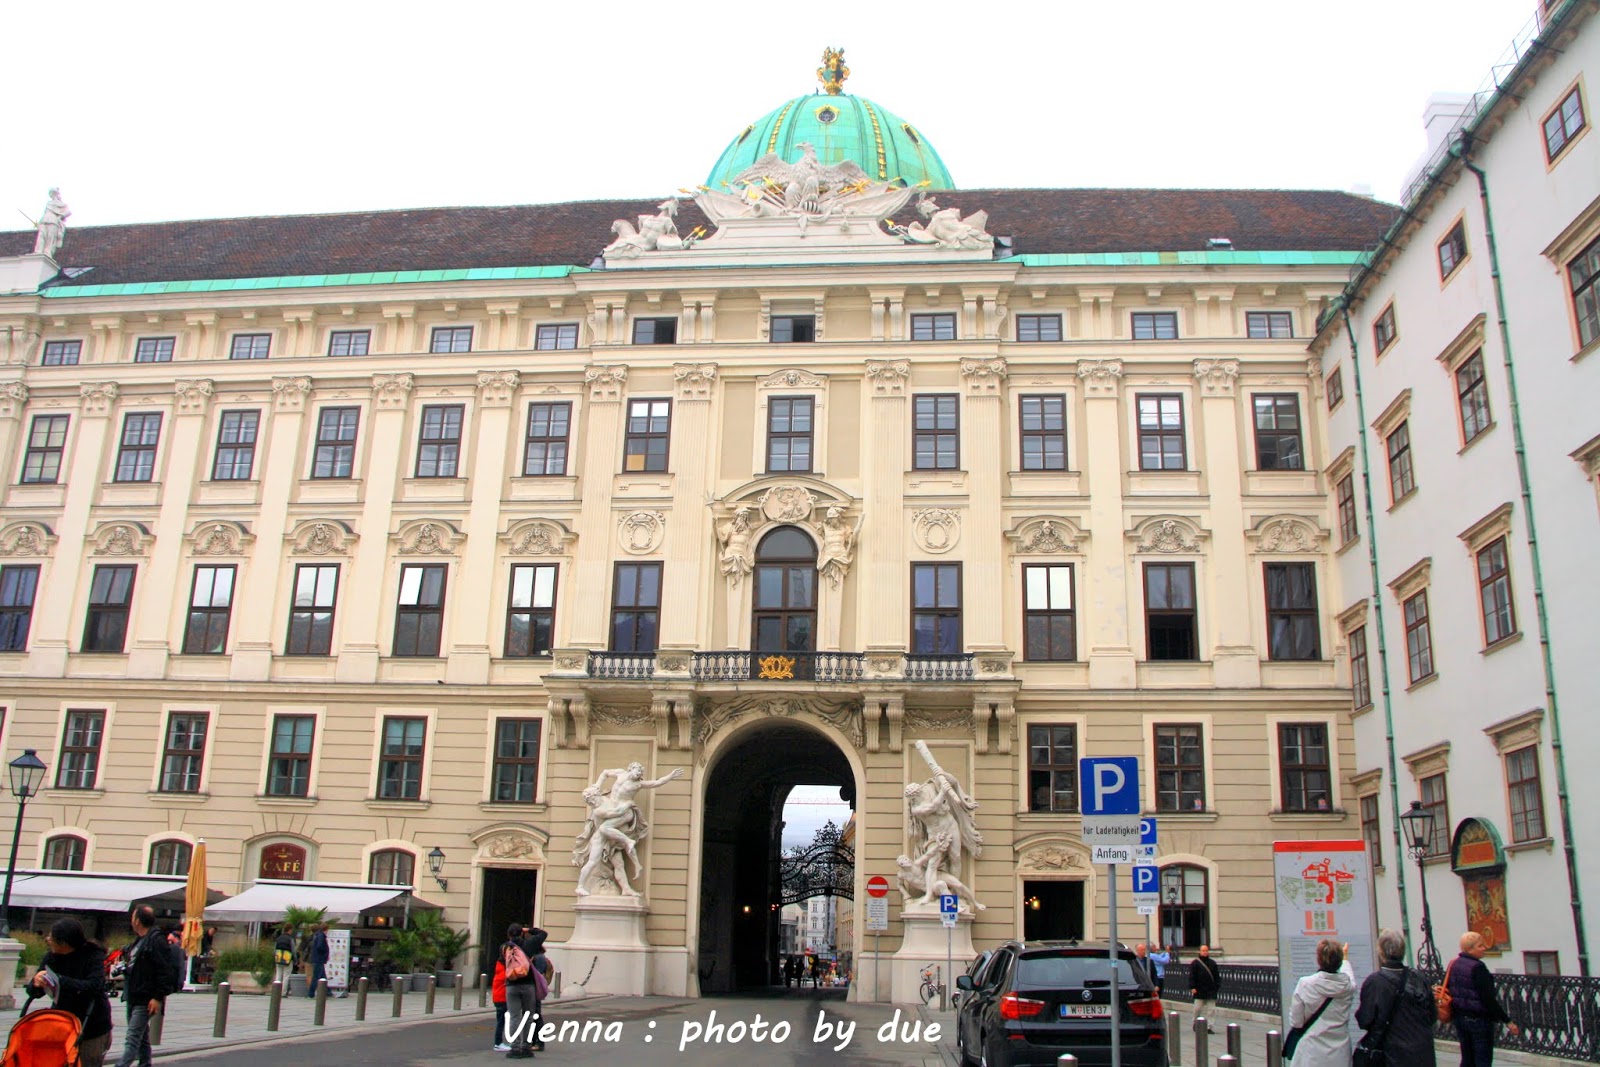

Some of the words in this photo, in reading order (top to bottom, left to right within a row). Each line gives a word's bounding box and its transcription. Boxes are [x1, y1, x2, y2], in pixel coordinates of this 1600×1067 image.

[1093, 763, 1125, 811] P
[1083, 826, 1093, 835] für
[1095, 825, 1139, 837] Ladetätigkeit
[1096, 848, 1127, 861] Anfang
[263, 860, 300, 872] CAFÉ
[1138, 868, 1153, 891] P
